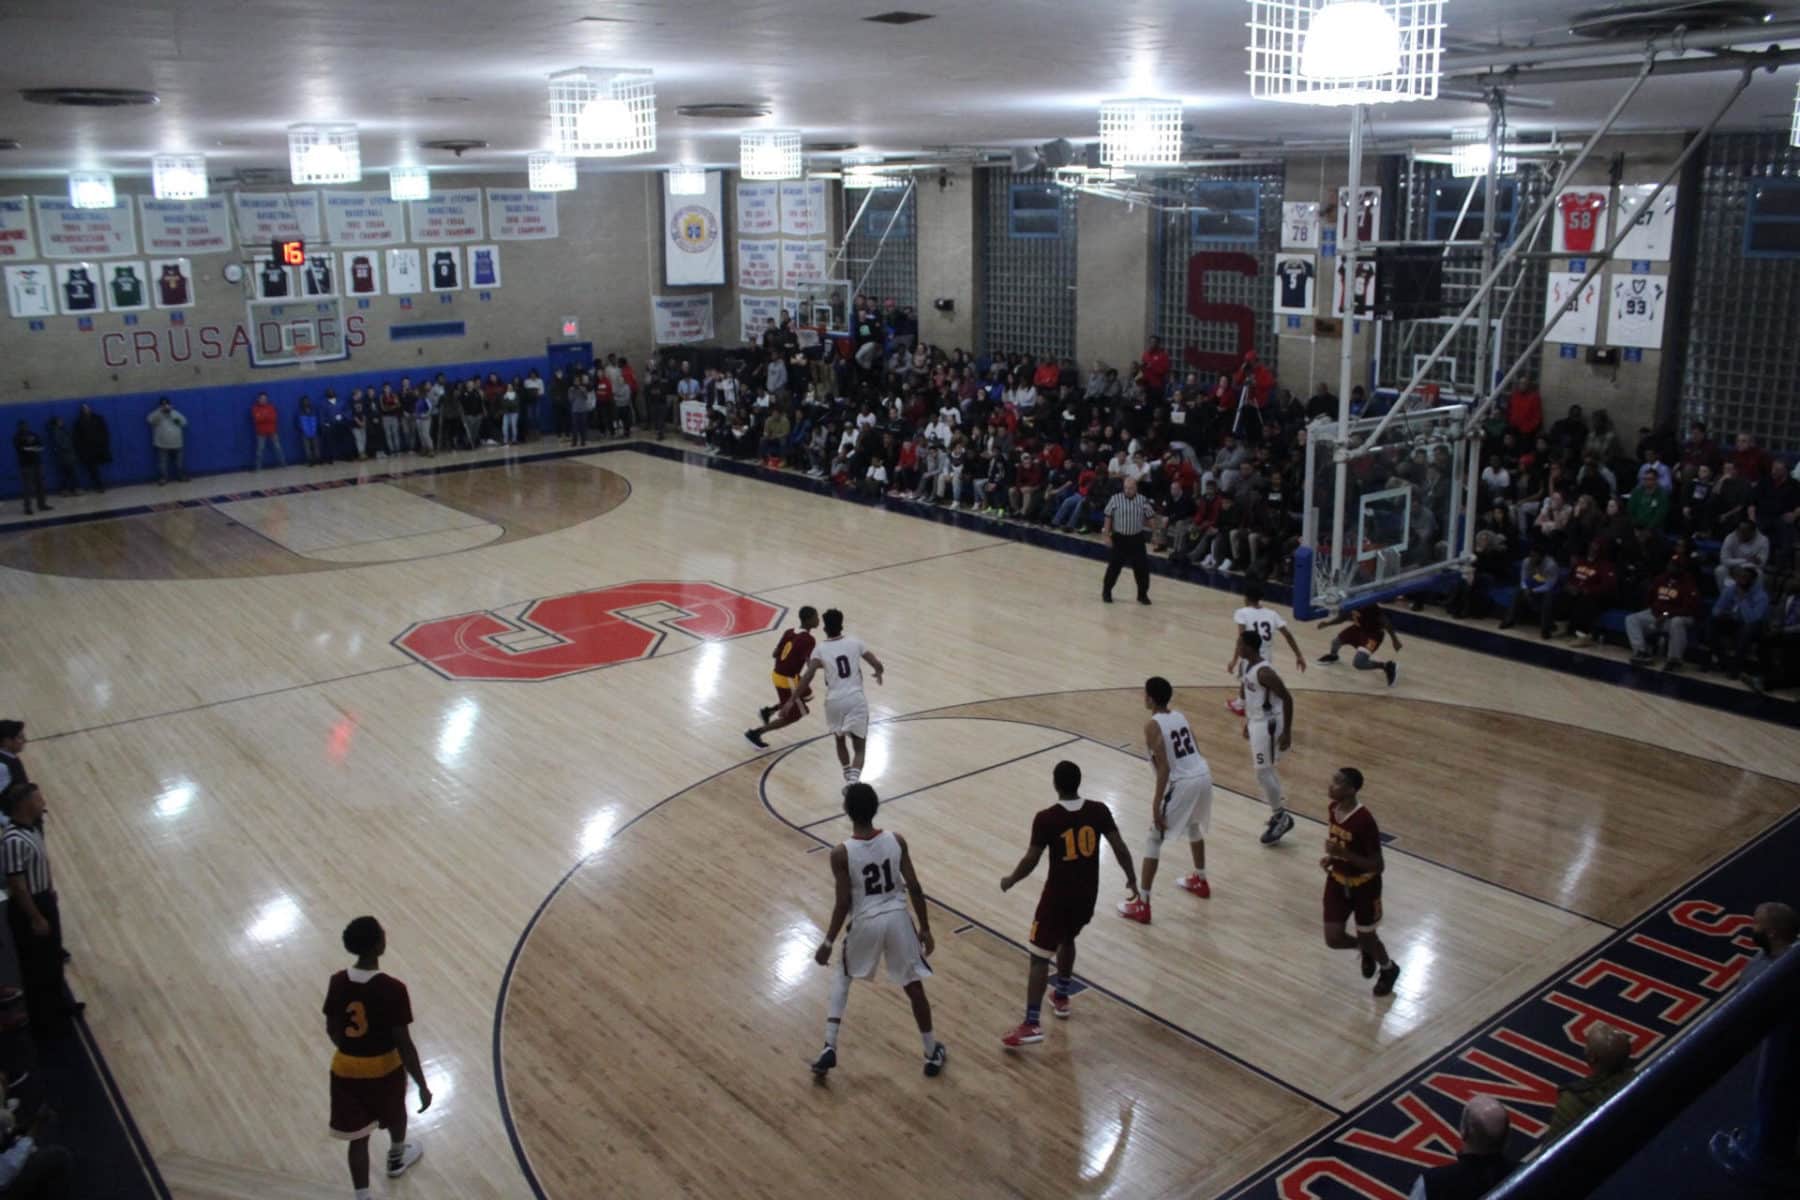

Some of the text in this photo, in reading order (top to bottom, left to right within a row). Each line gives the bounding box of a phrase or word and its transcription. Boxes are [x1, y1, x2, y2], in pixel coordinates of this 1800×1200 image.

[1569, 212, 1591, 229] 58
[1292, 225, 1309, 241] 78
[1184, 251, 1259, 371] S
[1626, 299, 1647, 315] 93
[1253, 621, 1273, 642] 13
[781, 640, 793, 661] 0
[835, 654, 852, 679] 0
[1170, 726, 1195, 760] 22
[1256, 752, 1265, 765] S
[1060, 824, 1097, 862] 10
[862, 858, 896, 897] 21
[344, 1000, 369, 1038] 3
